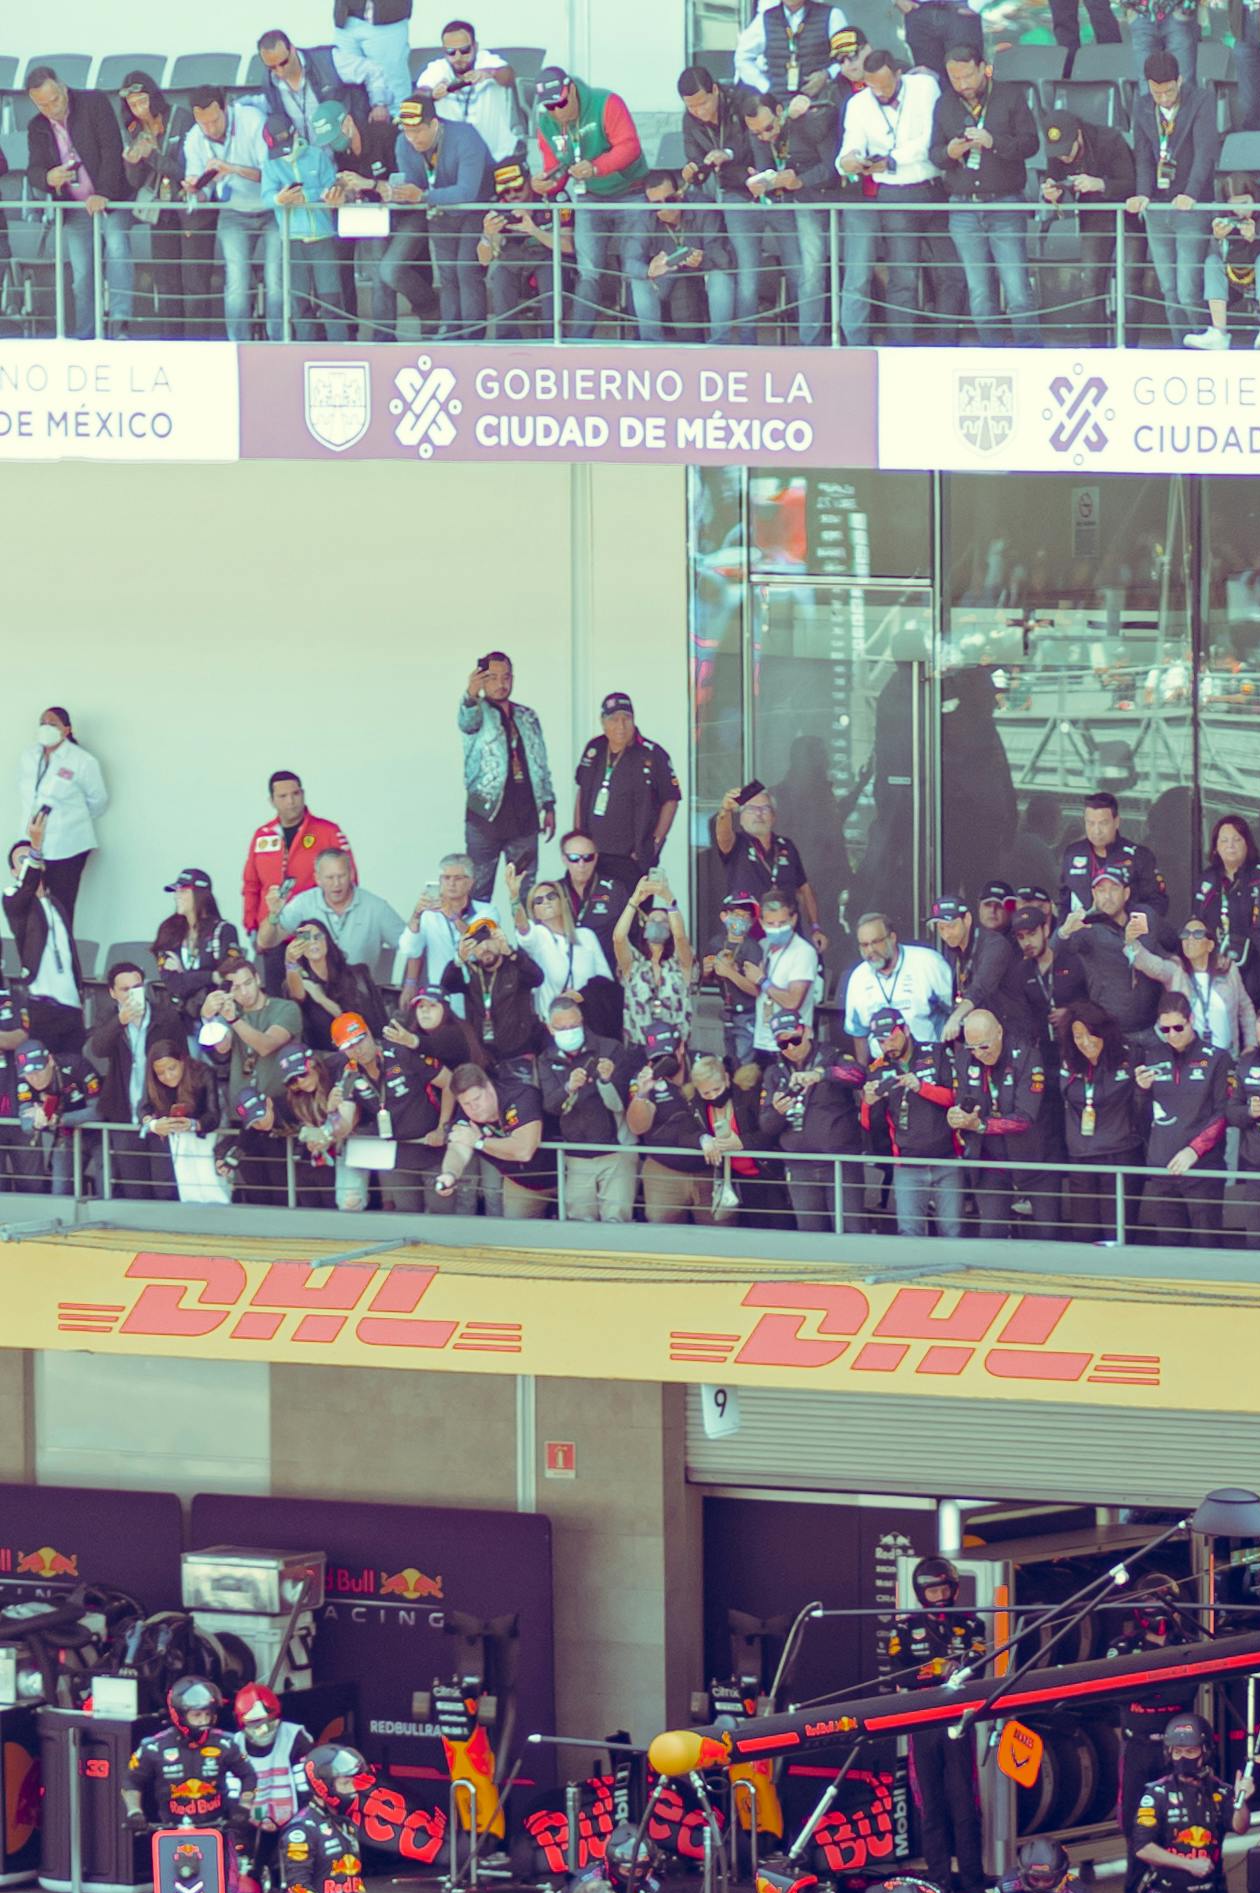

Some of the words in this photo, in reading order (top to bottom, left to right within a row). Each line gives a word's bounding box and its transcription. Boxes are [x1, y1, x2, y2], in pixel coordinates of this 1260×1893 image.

[67, 364, 111, 392] DE
[130, 365, 172, 392] LA
[474, 367, 684, 402] GOBIERNO
[699, 370, 749, 404] DE
[764, 372, 814, 404] LA
[46, 402, 173, 439] MÉXICO
[474, 414, 610, 448] CIUDAD
[619, 416, 667, 449] DE
[677, 409, 814, 452] MÉXICO
[118, 1251, 460, 1349] DHL
[733, 1280, 1094, 1381] DHL
[713, 1388, 728, 1419] 9
[336, 1567, 375, 1594] Bull
[323, 1605, 445, 1629] ACING
[369, 1719, 442, 1738] REDBULLRA
[169, 1796, 197, 1816] Red
[648, 1787, 726, 1861] ed
[894, 1788, 910, 1857] Mobil
